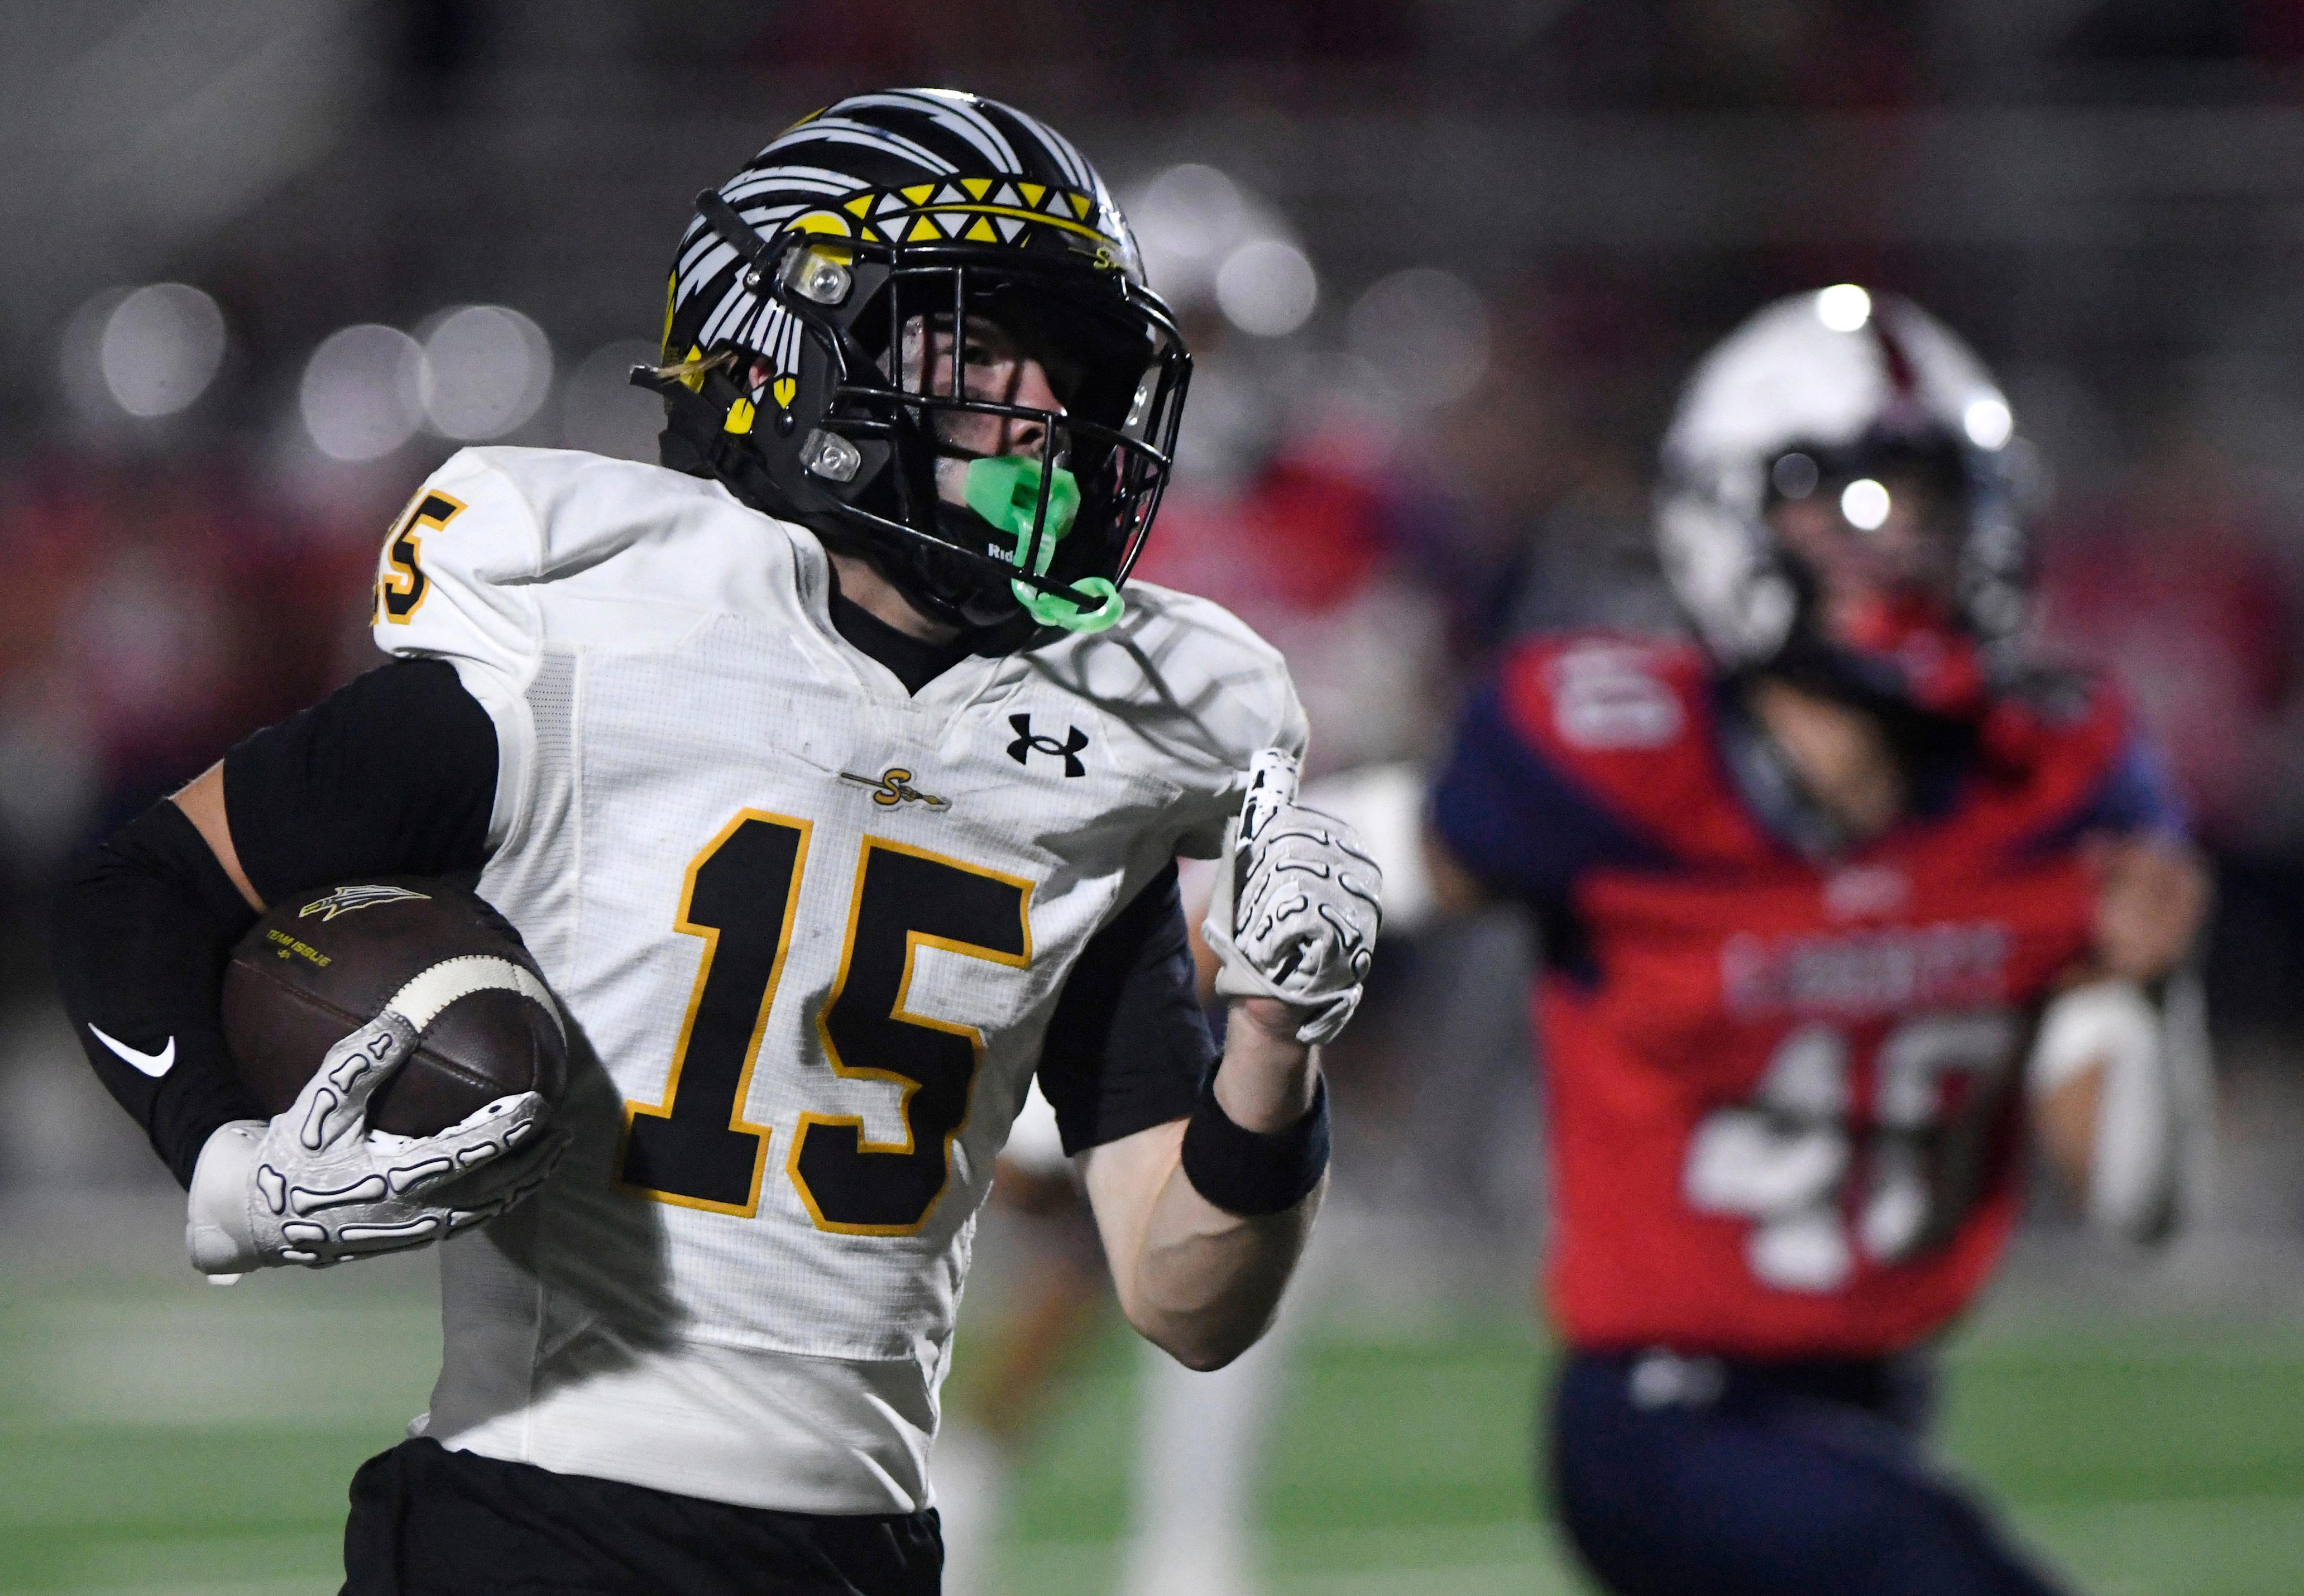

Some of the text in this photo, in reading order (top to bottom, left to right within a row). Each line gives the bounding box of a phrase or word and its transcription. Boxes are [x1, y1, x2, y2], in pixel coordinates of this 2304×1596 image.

[266, 929, 332, 967] TEAM ISSUE
[612, 807, 1036, 1236] 15
